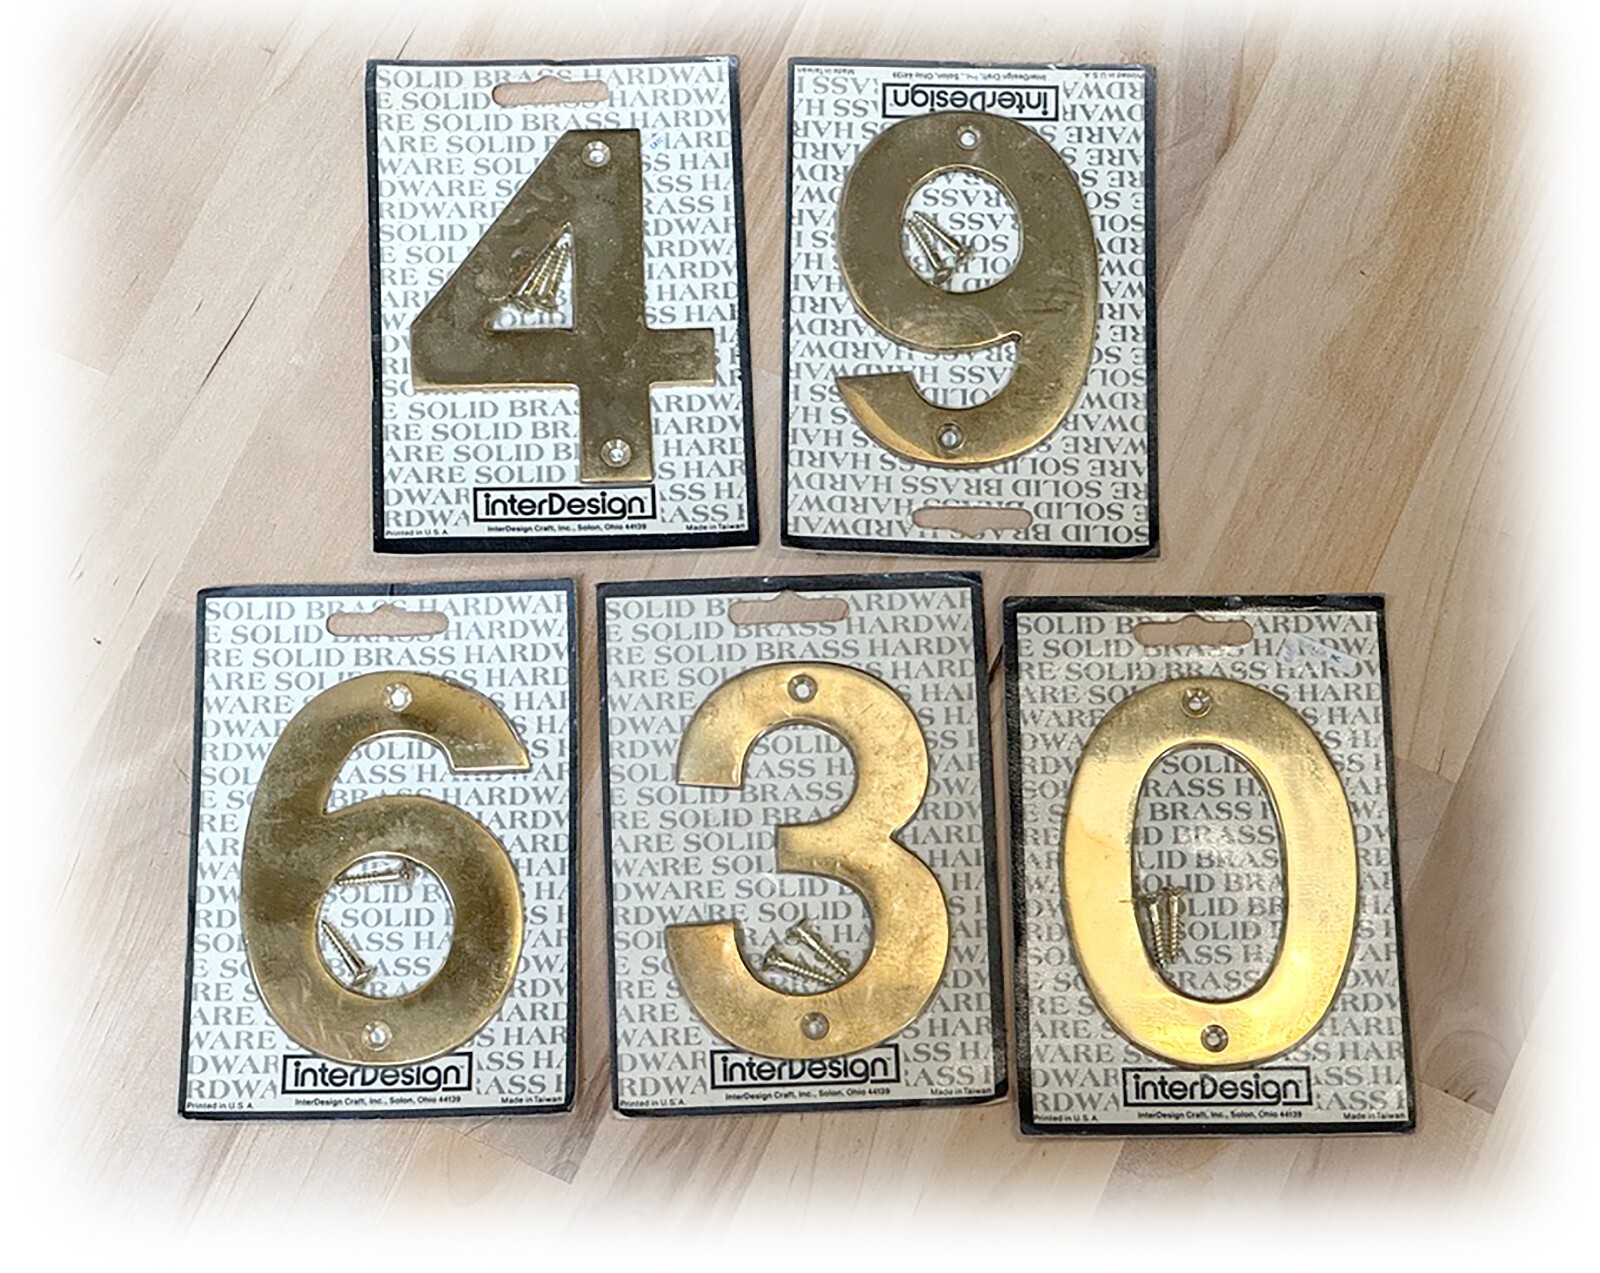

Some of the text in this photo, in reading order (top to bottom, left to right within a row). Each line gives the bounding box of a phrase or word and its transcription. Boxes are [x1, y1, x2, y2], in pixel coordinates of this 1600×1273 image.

[377, 70, 462, 88] SOLID
[402, 92, 489, 110] SOLID
[423, 113, 512, 131] SOLID
[521, 112, 621, 130] BRASS
[379, 135, 535, 153] ARE SOLID
[380, 157, 464, 176] WARE
[380, 179, 487, 197] DWARE
[380, 224, 467, 242] SOLID
[409, 401, 498, 419] SOLID
[431, 422, 522, 441] SOLID
[384, 443, 544, 463] ARE SOLID
[475, 465, 565, 483] SOLID
[1087, 459, 1146, 477] ARE
[902, 476, 1002, 496] BRASS
[1011, 479, 1101, 498] SOLID
[484, 492, 645, 518] interDesign
[1032, 501, 1124, 522] SOLID
[1061, 524, 1149, 544] SOLID
[206, 601, 295, 621] SOLID
[606, 600, 695, 621] SOLID
[231, 623, 322, 644] SOLID
[631, 622, 723, 642] SOLID
[1017, 615, 1106, 636] SOLID
[253, 648, 345, 667] SOLID
[354, 646, 455, 666] BRASS
[654, 642, 746, 664] SOLID
[756, 639, 860, 661] BRASS
[1043, 638, 1133, 658] SOLID
[608, 669, 669, 688] ARE
[1064, 661, 1156, 681] SOLID
[1165, 660, 1267, 680] BRASS
[206, 672, 266, 690] ARE
[205, 696, 294, 714] WARE
[610, 691, 696, 711] WARE
[348, 742, 436, 760] SOLID
[752, 734, 842, 754] SOLID
[1161, 755, 1253, 774] SOLID
[739, 781, 843, 802] BRASS
[658, 807, 752, 828] SOLID
[1149, 801, 1253, 821] BRASS
[612, 831, 776, 852] ARE SOLID
[614, 856, 704, 877] WARE
[735, 878, 829, 899] SOLID
[341, 907, 434, 927] SOLID
[757, 902, 852, 922] SOLID
[1133, 1073, 1300, 1100] interDesign
[295, 1098, 342, 1106] InterDesign
[417, 1096, 437, 1104] Ohio
[726, 1093, 772, 1101] InterDesign
